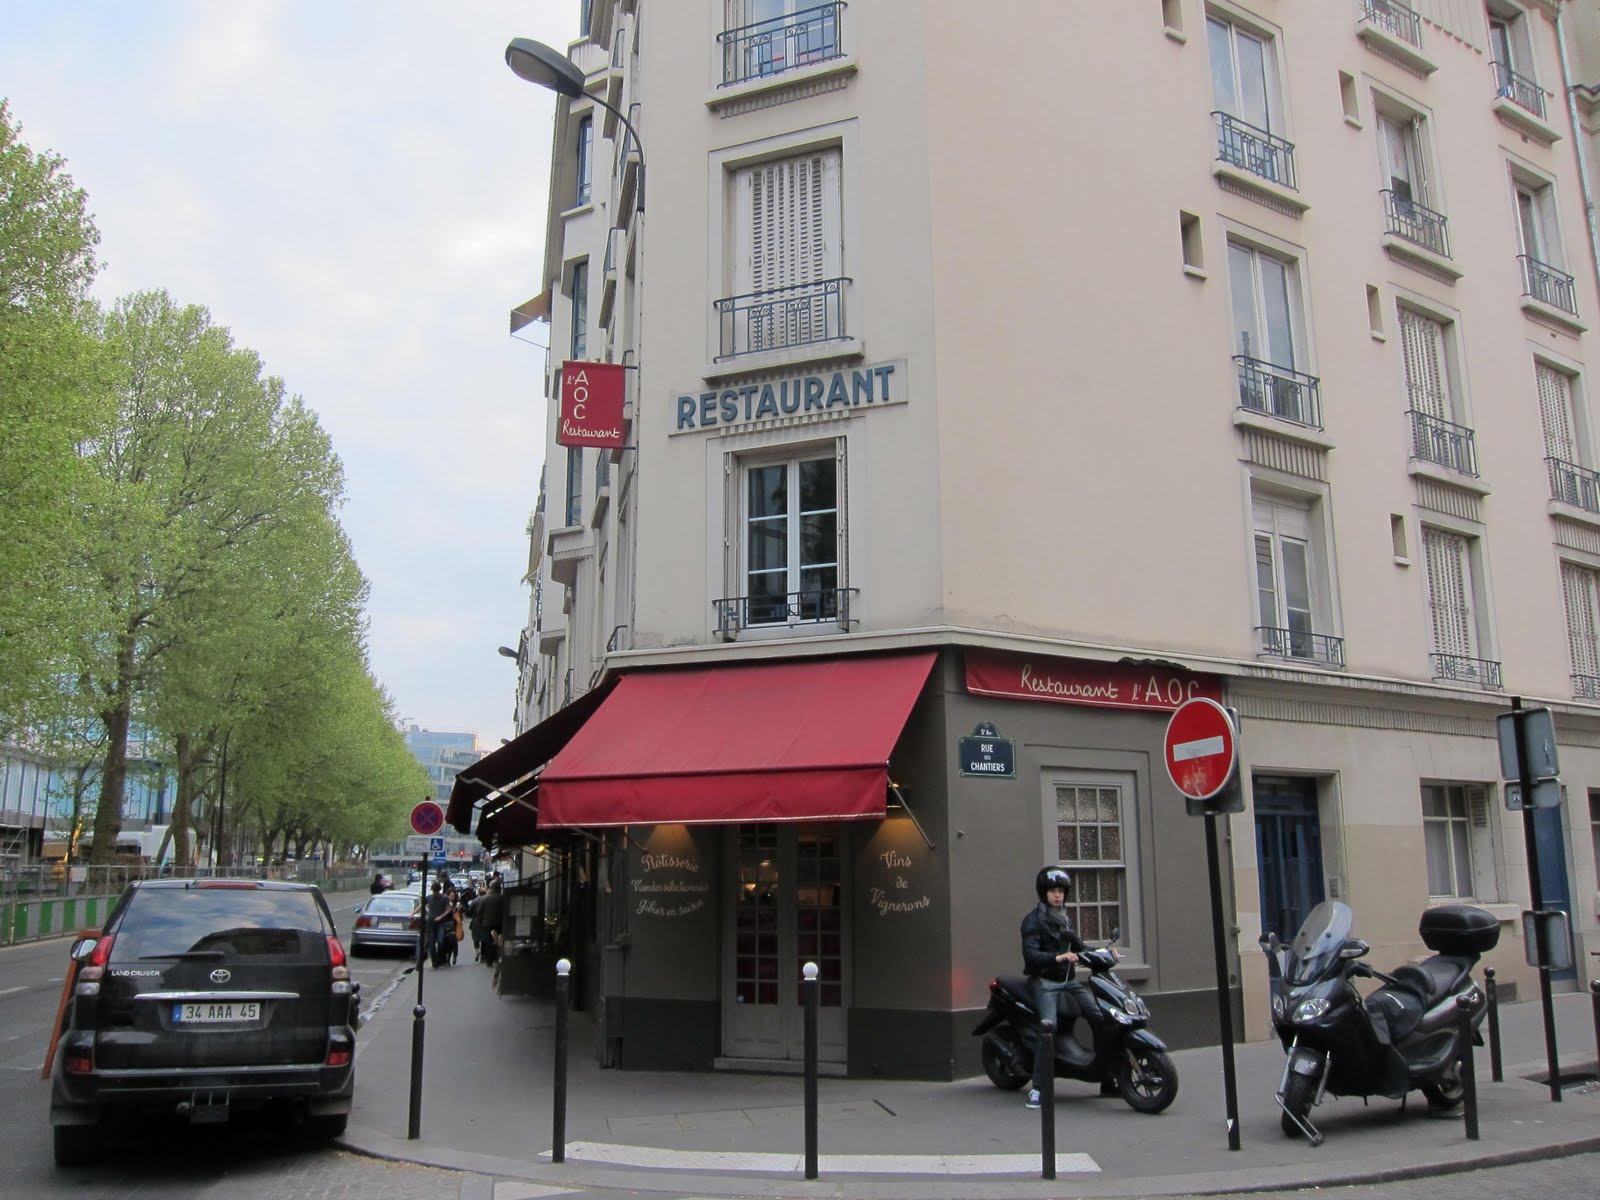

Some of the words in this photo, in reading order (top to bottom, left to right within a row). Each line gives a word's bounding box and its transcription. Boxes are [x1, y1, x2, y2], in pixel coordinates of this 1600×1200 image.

[677, 365, 895, 429] RESTAURANT
[562, 419, 620, 438] Restaurant
[1021, 664, 1119, 699] Restaurant
[980, 744, 994, 753] RUE
[970, 762, 1006, 772] CHANTIERS
[880, 851, 912, 869] Vins
[896, 876, 909, 889] de
[870, 887, 931, 916] Vignerons
[186, 1005, 202, 1019] 34
[208, 1004, 233, 1019] AAA
[240, 1004, 257, 1018] 45
